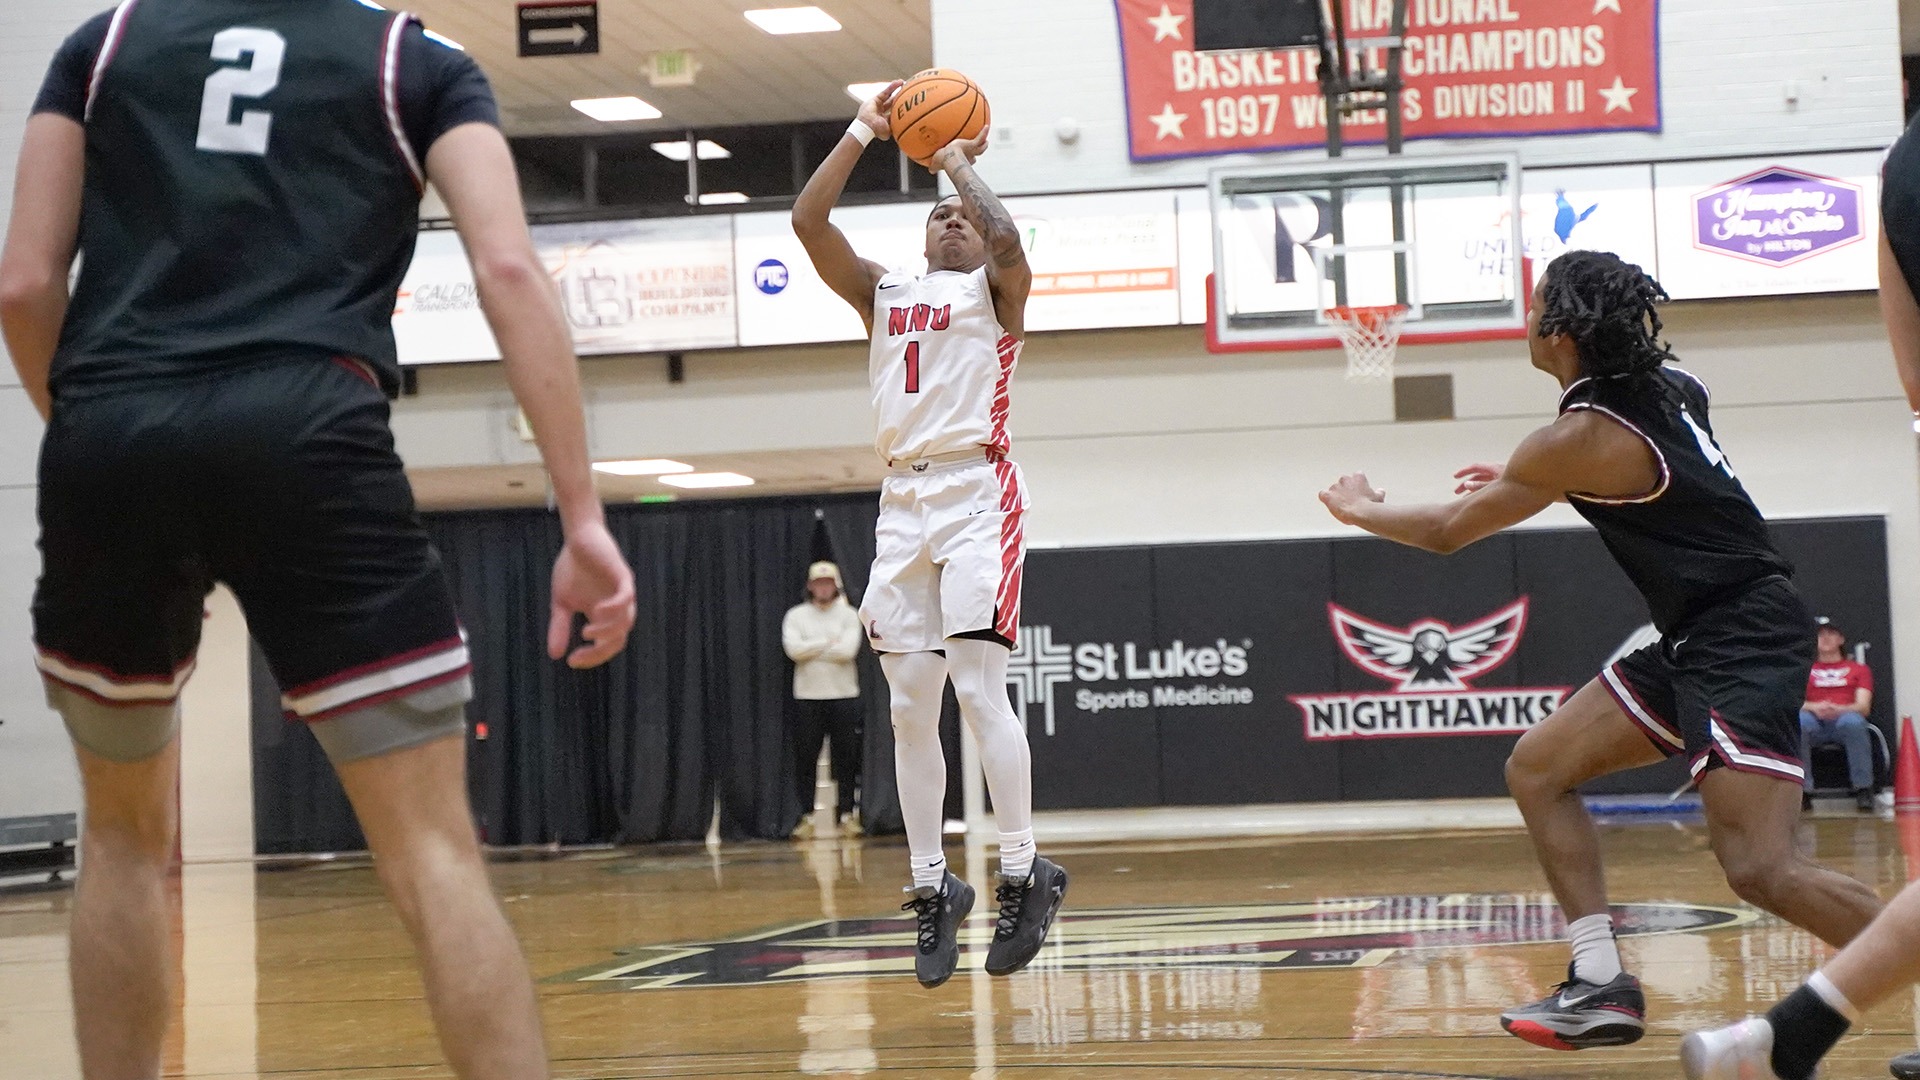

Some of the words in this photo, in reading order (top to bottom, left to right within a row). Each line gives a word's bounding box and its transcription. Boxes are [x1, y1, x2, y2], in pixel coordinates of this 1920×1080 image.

[1348, 0, 1521, 31] NAIONAL
[1402, 24, 1606, 77] CHAMPIONS
[195, 26, 287, 156] 2
[897, 90, 927, 121] EVO
[1200, 93, 1281, 138] 1997
[1433, 80, 1554, 120] DIVISION
[1566, 79, 1586, 114] II
[888, 303, 951, 336] NNU
[904, 341, 919, 393] 1
[1075, 641, 1119, 681] St
[1075, 687, 1150, 714] Sports
[1153, 683, 1254, 707] Medicine
[1310, 694, 1554, 732] NIGHTHAWKS
